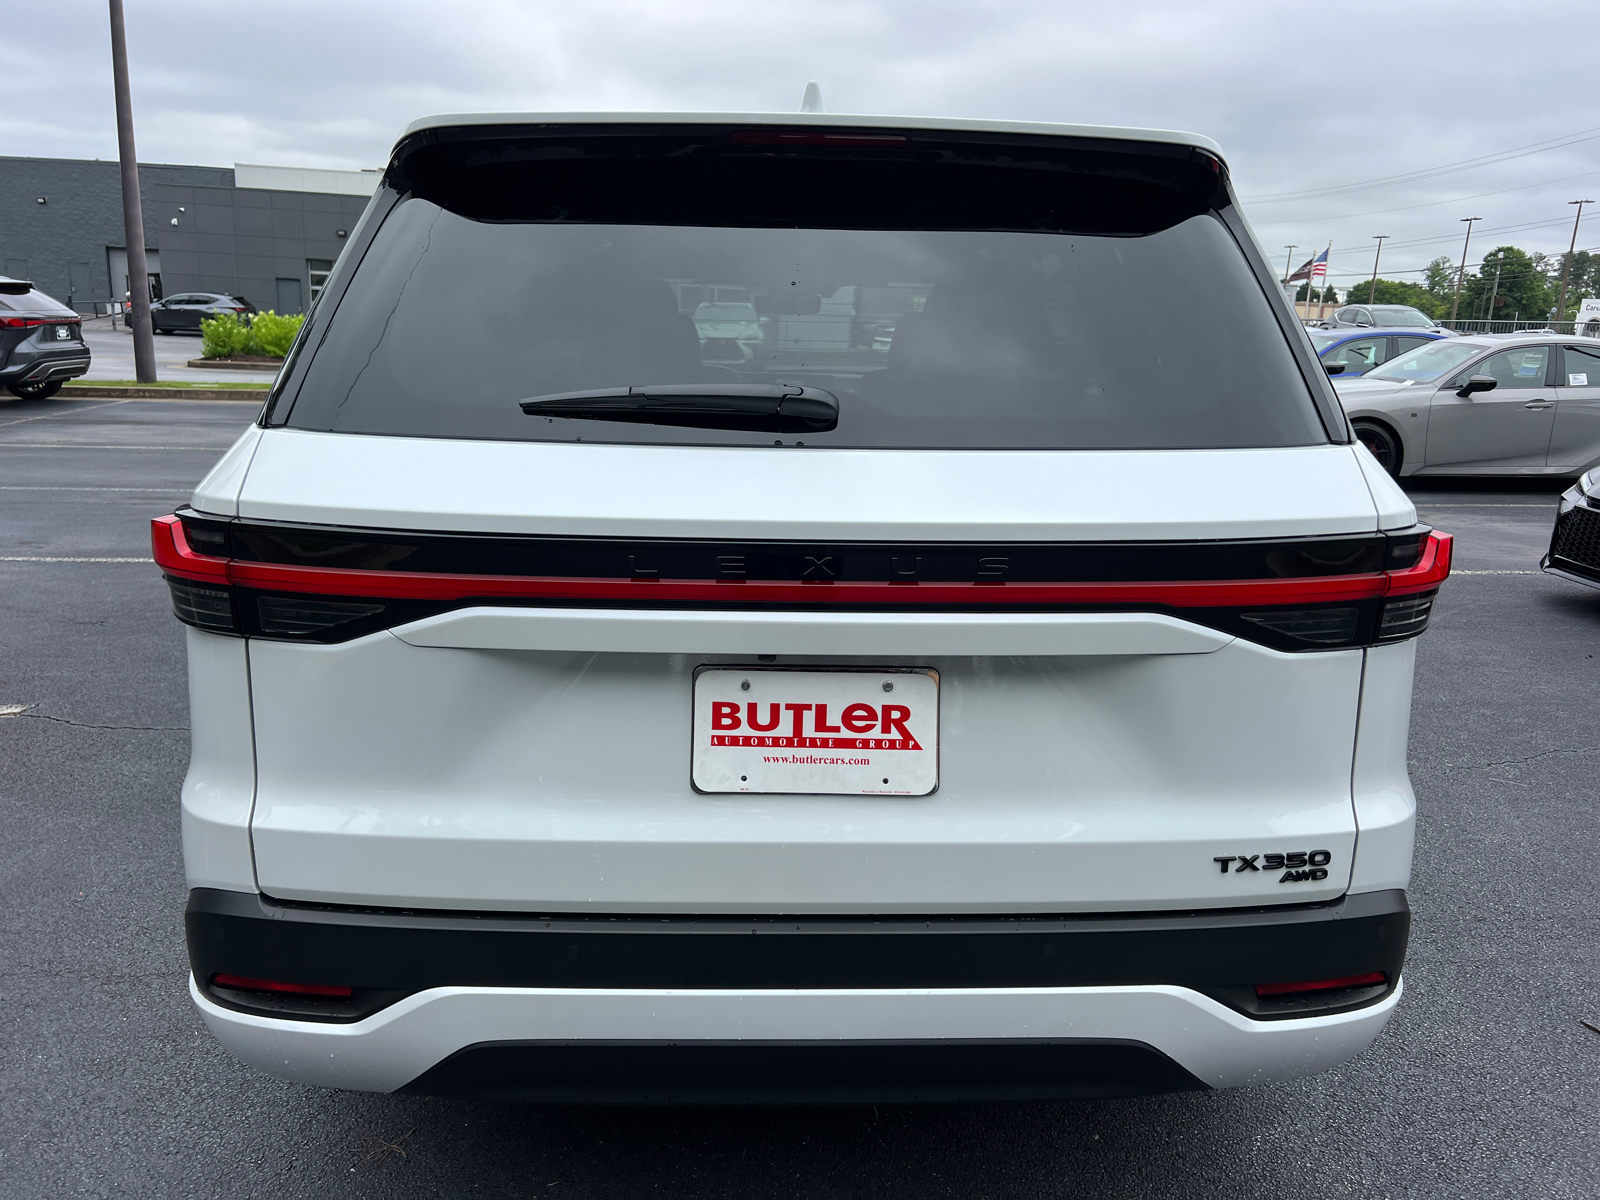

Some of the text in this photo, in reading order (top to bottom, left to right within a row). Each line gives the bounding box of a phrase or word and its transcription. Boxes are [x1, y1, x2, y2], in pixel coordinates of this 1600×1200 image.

[628, 554, 1010, 576] LEXUS
[711, 736, 915, 749] AUTOMOTIVE GROUP
[763, 754, 870, 766] www.butlercars.com
[1279, 868, 1328, 883] AWD
